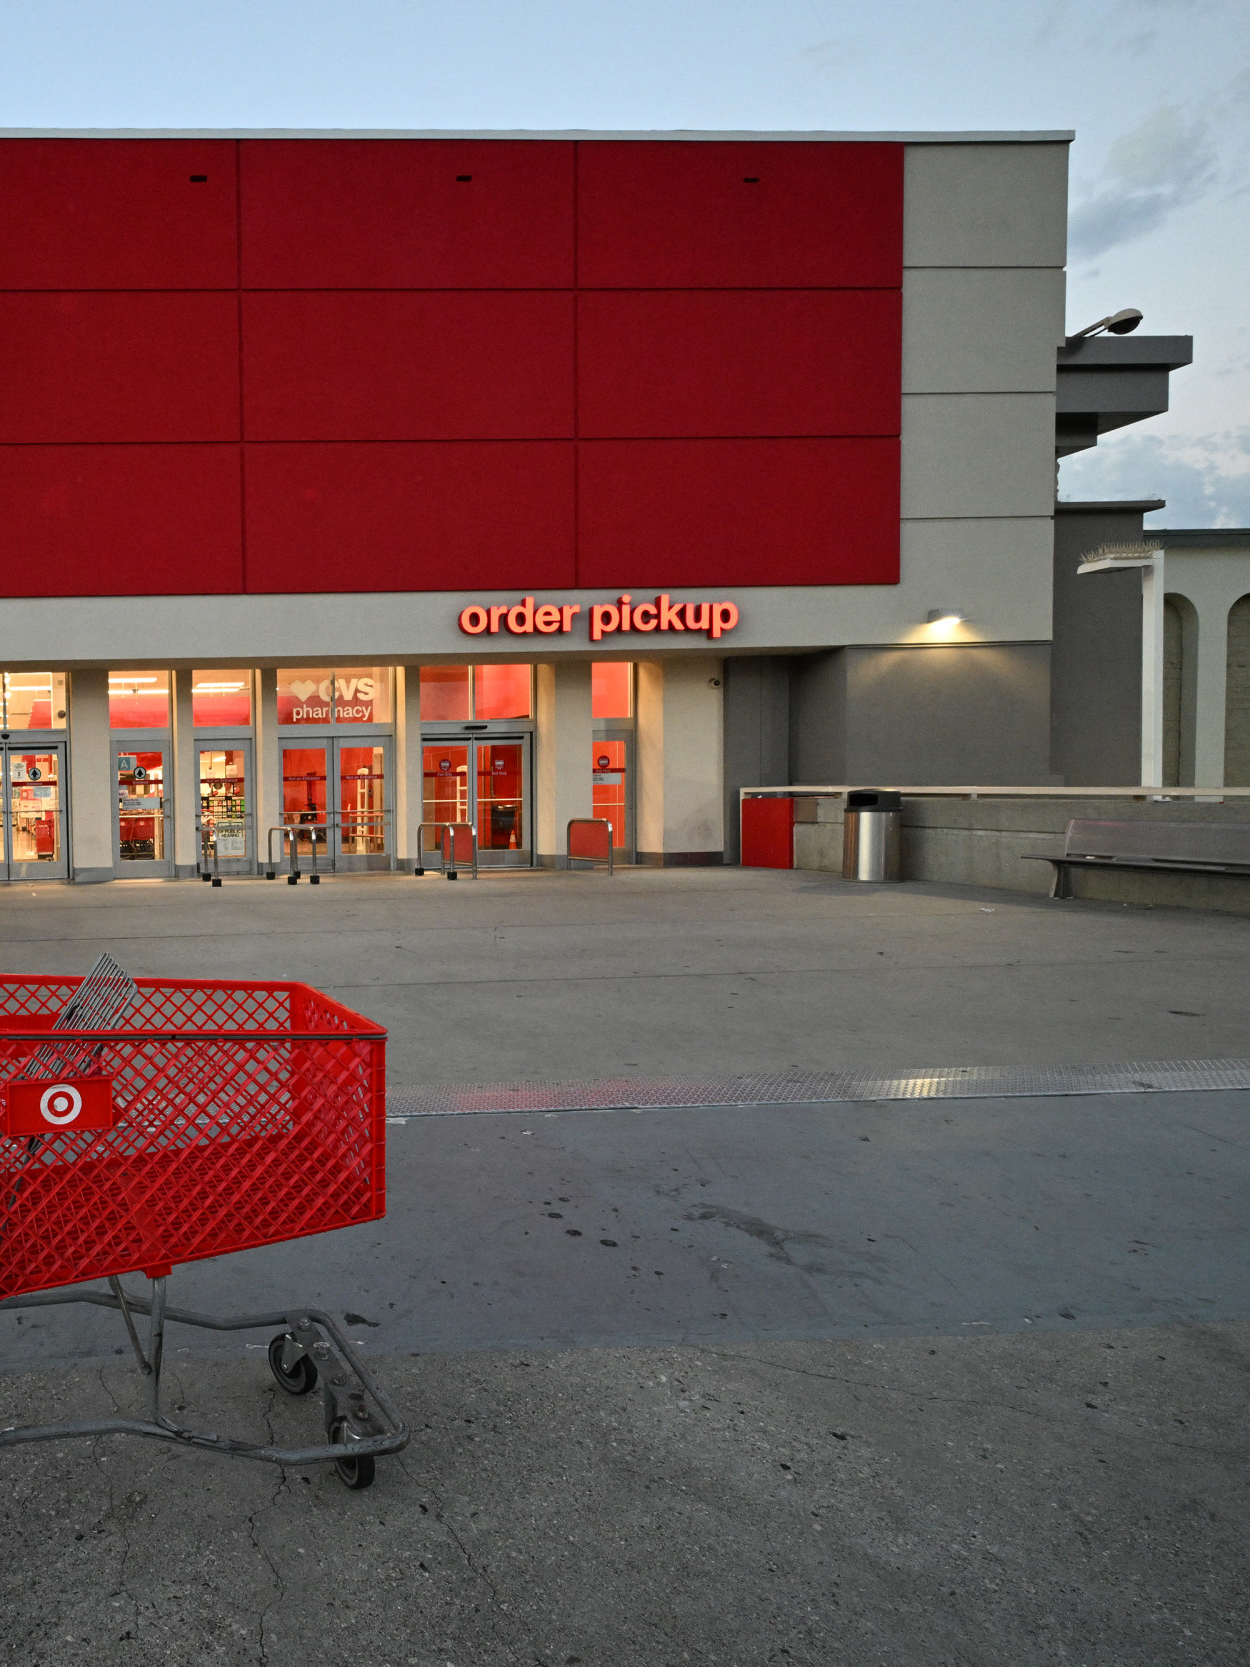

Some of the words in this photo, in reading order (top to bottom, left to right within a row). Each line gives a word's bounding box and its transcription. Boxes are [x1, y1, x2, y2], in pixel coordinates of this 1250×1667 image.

[458, 596, 580, 635] order
[589, 594, 739, 641] pickup
[318, 677, 375, 702] CVS
[120, 760, 129, 769] A
